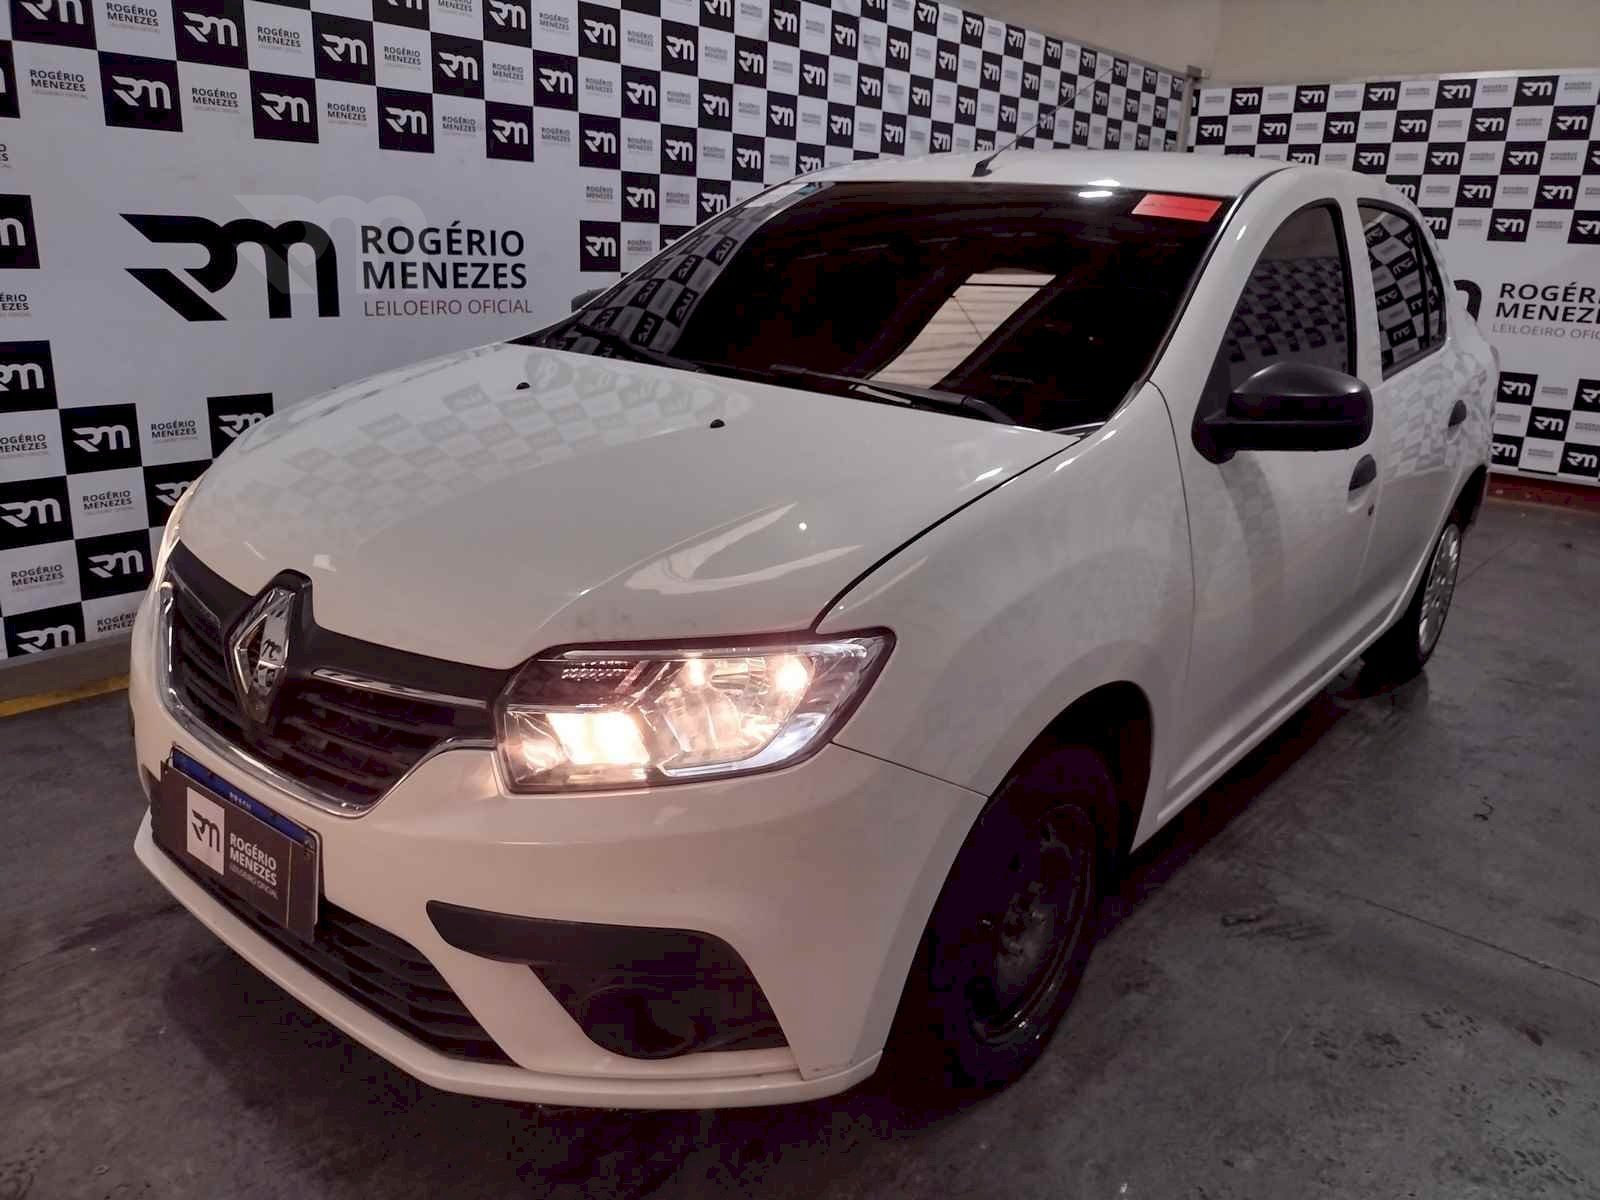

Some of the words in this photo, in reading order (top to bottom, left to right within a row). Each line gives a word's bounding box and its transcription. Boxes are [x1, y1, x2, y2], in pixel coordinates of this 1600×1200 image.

[106, 2, 157, 17] ROGÉRIO
[108, 12, 158, 26] MENEZES
[258, 26, 300, 39] ROGÉRIO
[258, 35, 300, 47] MENEZES
[384, 46, 420, 57] ROGÉRIO
[384, 53, 421, 65] MENEZES
[30, 70, 84, 82] ROGÉRIO
[31, 78, 86, 92] MENEZES
[192, 88, 237, 99] ROGÉRIO
[193, 96, 238, 108] MENEZES
[328, 103, 366, 113] ROGÉRIO
[328, 110, 366, 121] MENEZES
[442, 116, 476, 126] ROGÉRIO
[443, 123, 476, 132] MENEZES
[361, 221, 524, 257] ROGÉRIO
[363, 261, 527, 289] MENEZES
[364, 299, 462, 317] LEILOEIRO
[468, 297, 533, 315] OFICIAL
[1492, 324, 1566, 338] LEILOEIRO
[151, 420, 195, 430] ROGÉRIO
[152, 428, 196, 438] MENEZES
[83, 490, 130, 502] ROGÉRIO
[84, 498, 132, 510] MENEZES
[11, 564, 62, 578] ROGÉRIO
[12, 572, 64, 586] MENEZES
[230, 833, 277, 871] ROGÉRIO
[230, 847, 277, 886] MENEZES
